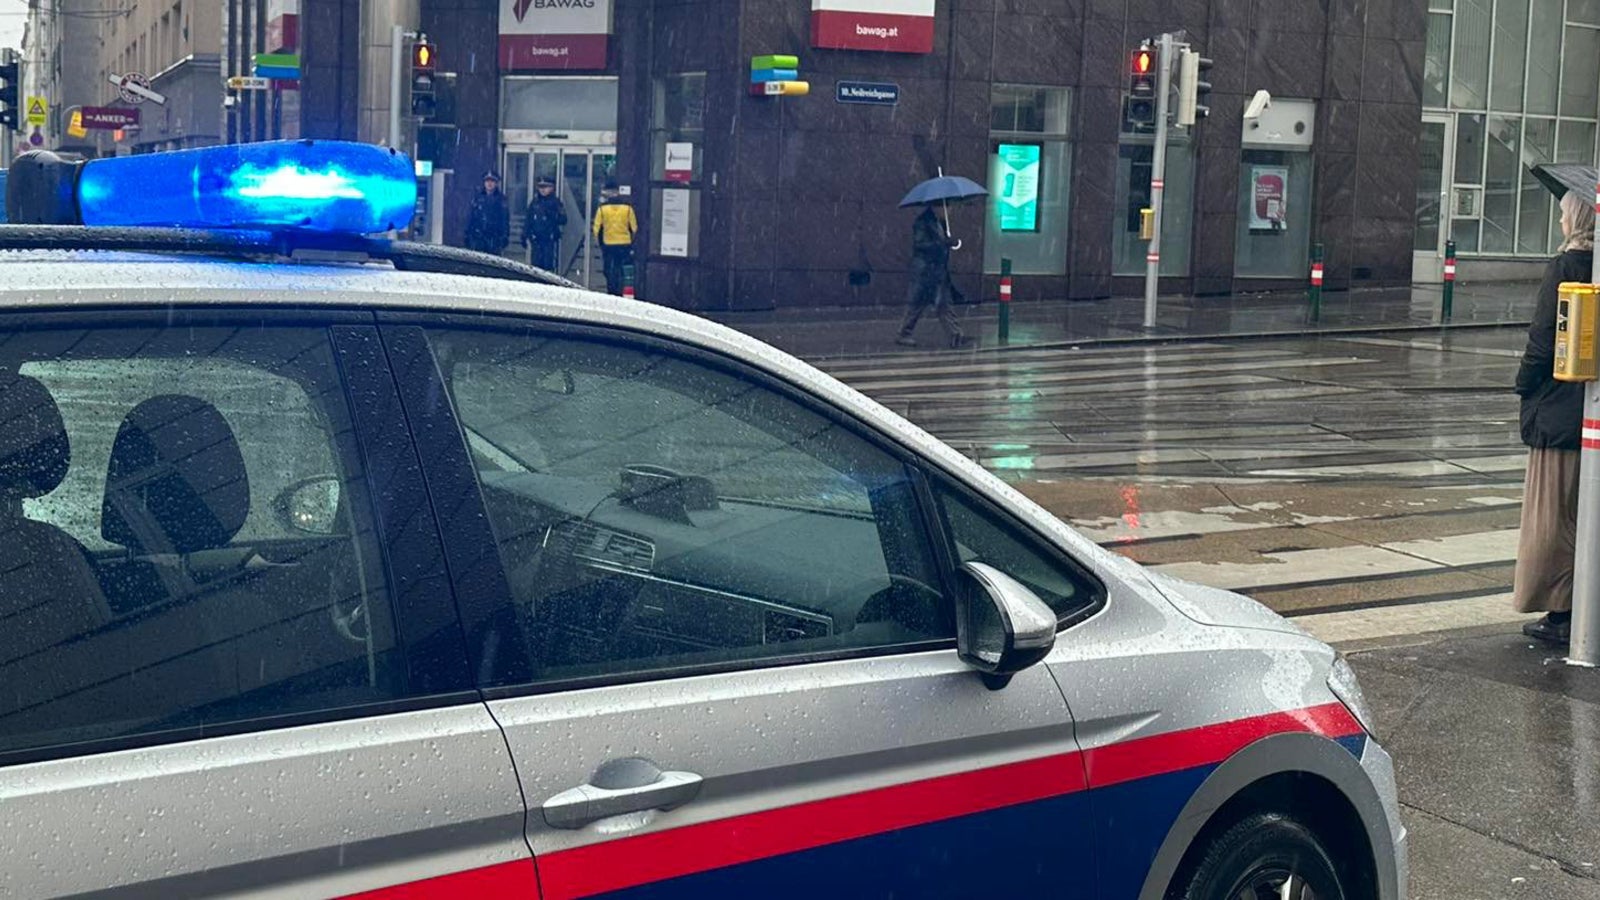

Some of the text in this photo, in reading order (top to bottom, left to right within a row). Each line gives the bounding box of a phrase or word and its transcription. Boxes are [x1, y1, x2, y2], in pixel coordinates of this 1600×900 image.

[534, 0, 595, 9] BAWAG
[856, 23, 898, 39] bawag.at
[532, 46, 569, 57] bawag.at
[94, 114, 126, 123] ANKER
